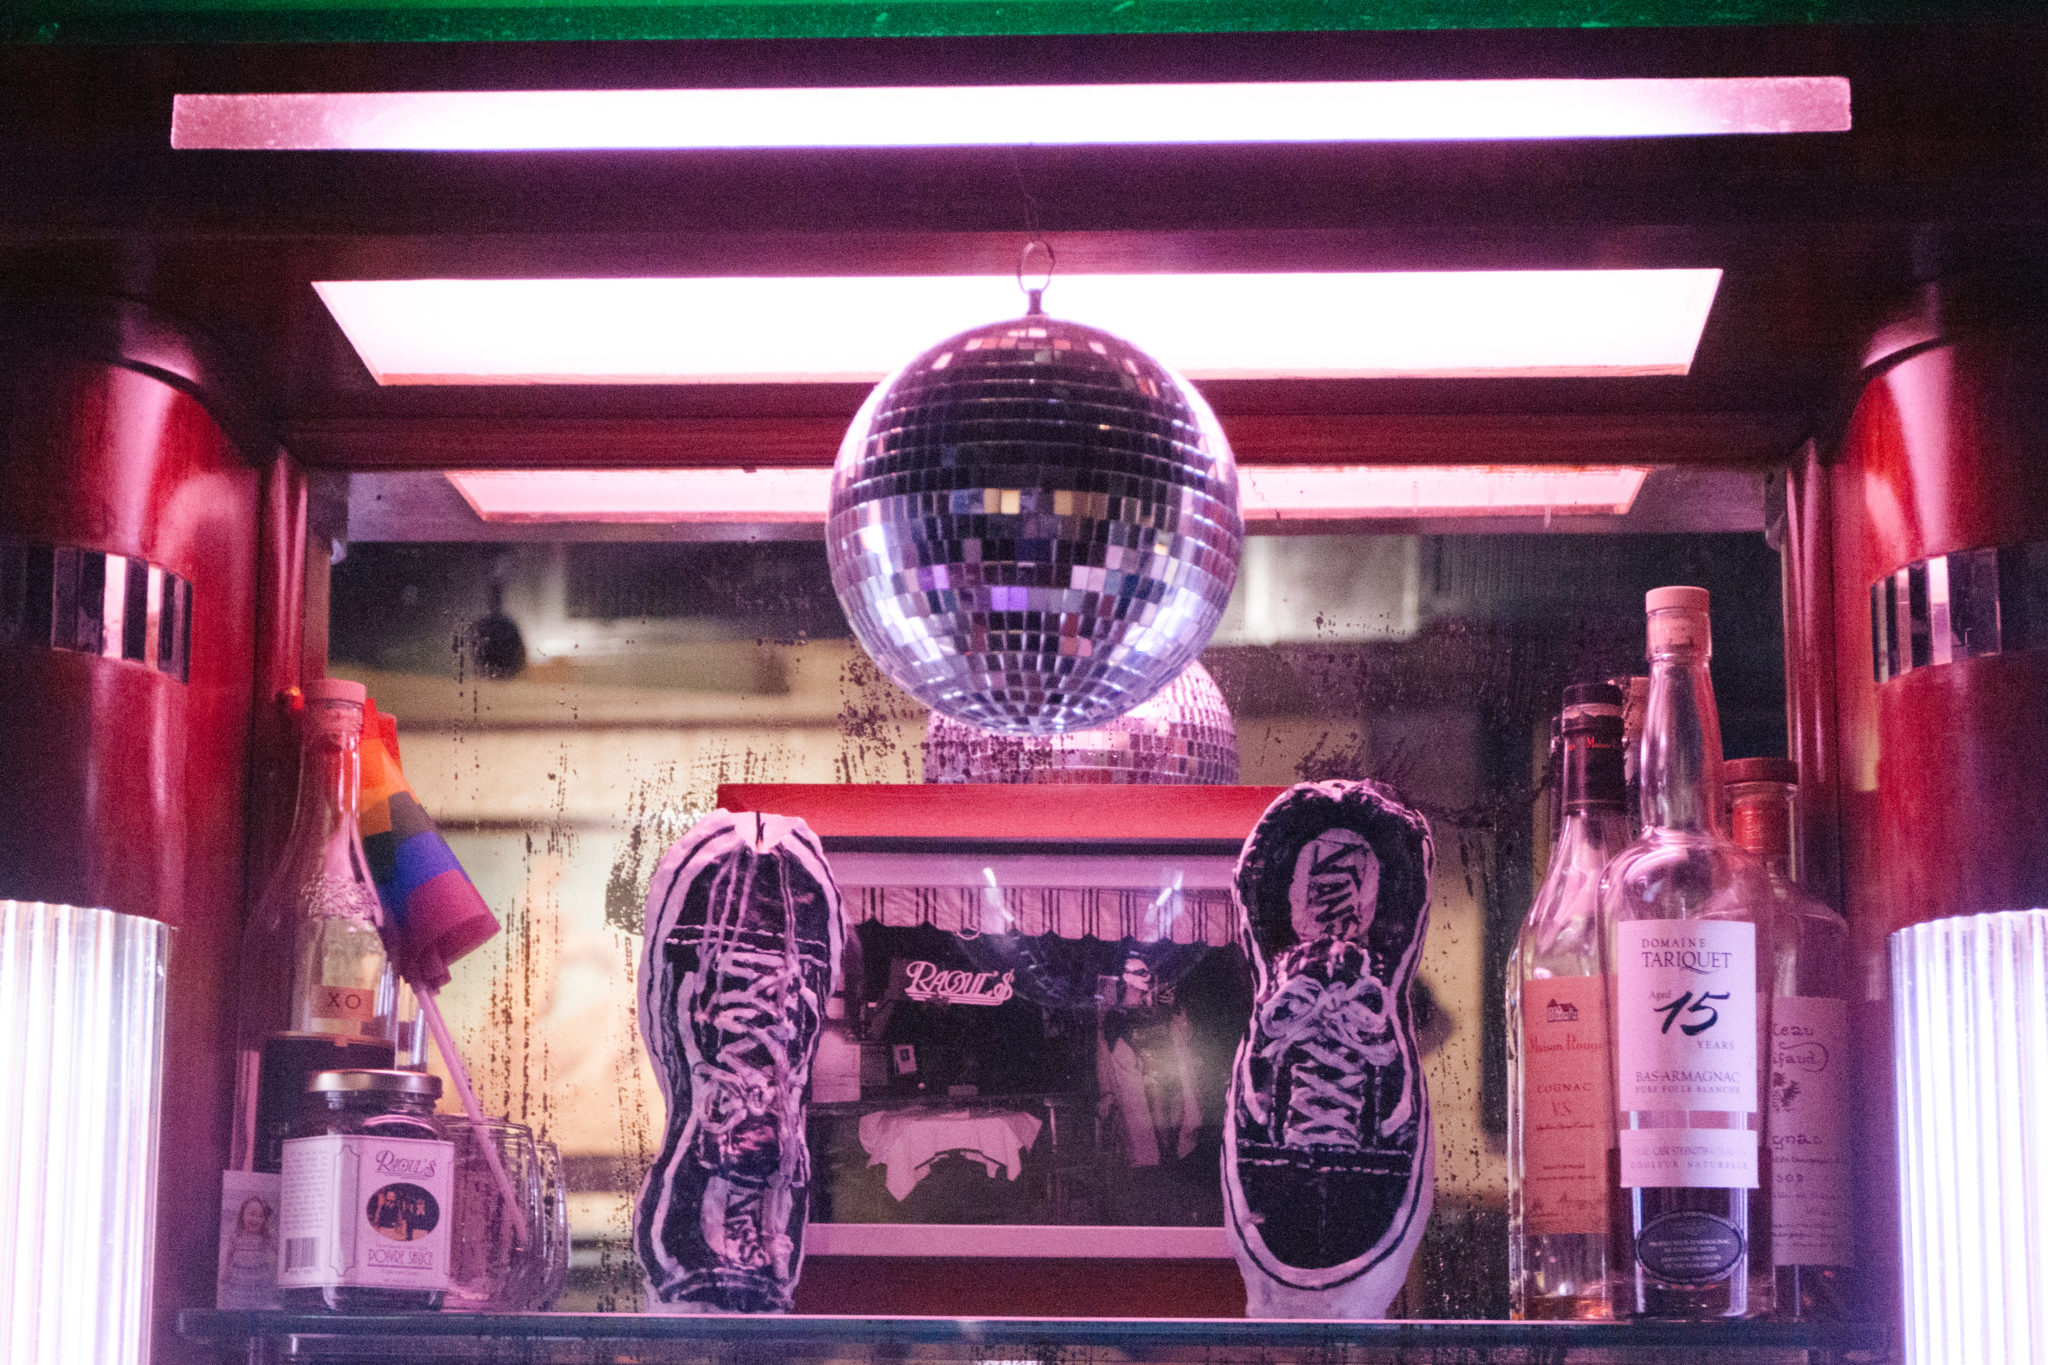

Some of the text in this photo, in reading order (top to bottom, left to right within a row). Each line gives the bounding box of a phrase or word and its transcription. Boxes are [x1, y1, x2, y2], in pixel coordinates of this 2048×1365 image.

[1641, 938, 1707, 949] DOMAINE
[1641, 950, 1733, 975] TARIQUET
[904, 960, 1015, 1006] RAOUL'S
[327, 992, 362, 1009] XO
[1648, 990, 1672, 1002] Aged
[1653, 991, 1731, 1036] 15
[1696, 1040, 1736, 1051] YEARS
[1635, 1071, 1741, 1083] BAS-ARMAGNAC
[1537, 1083, 1591, 1094] COGNAC
